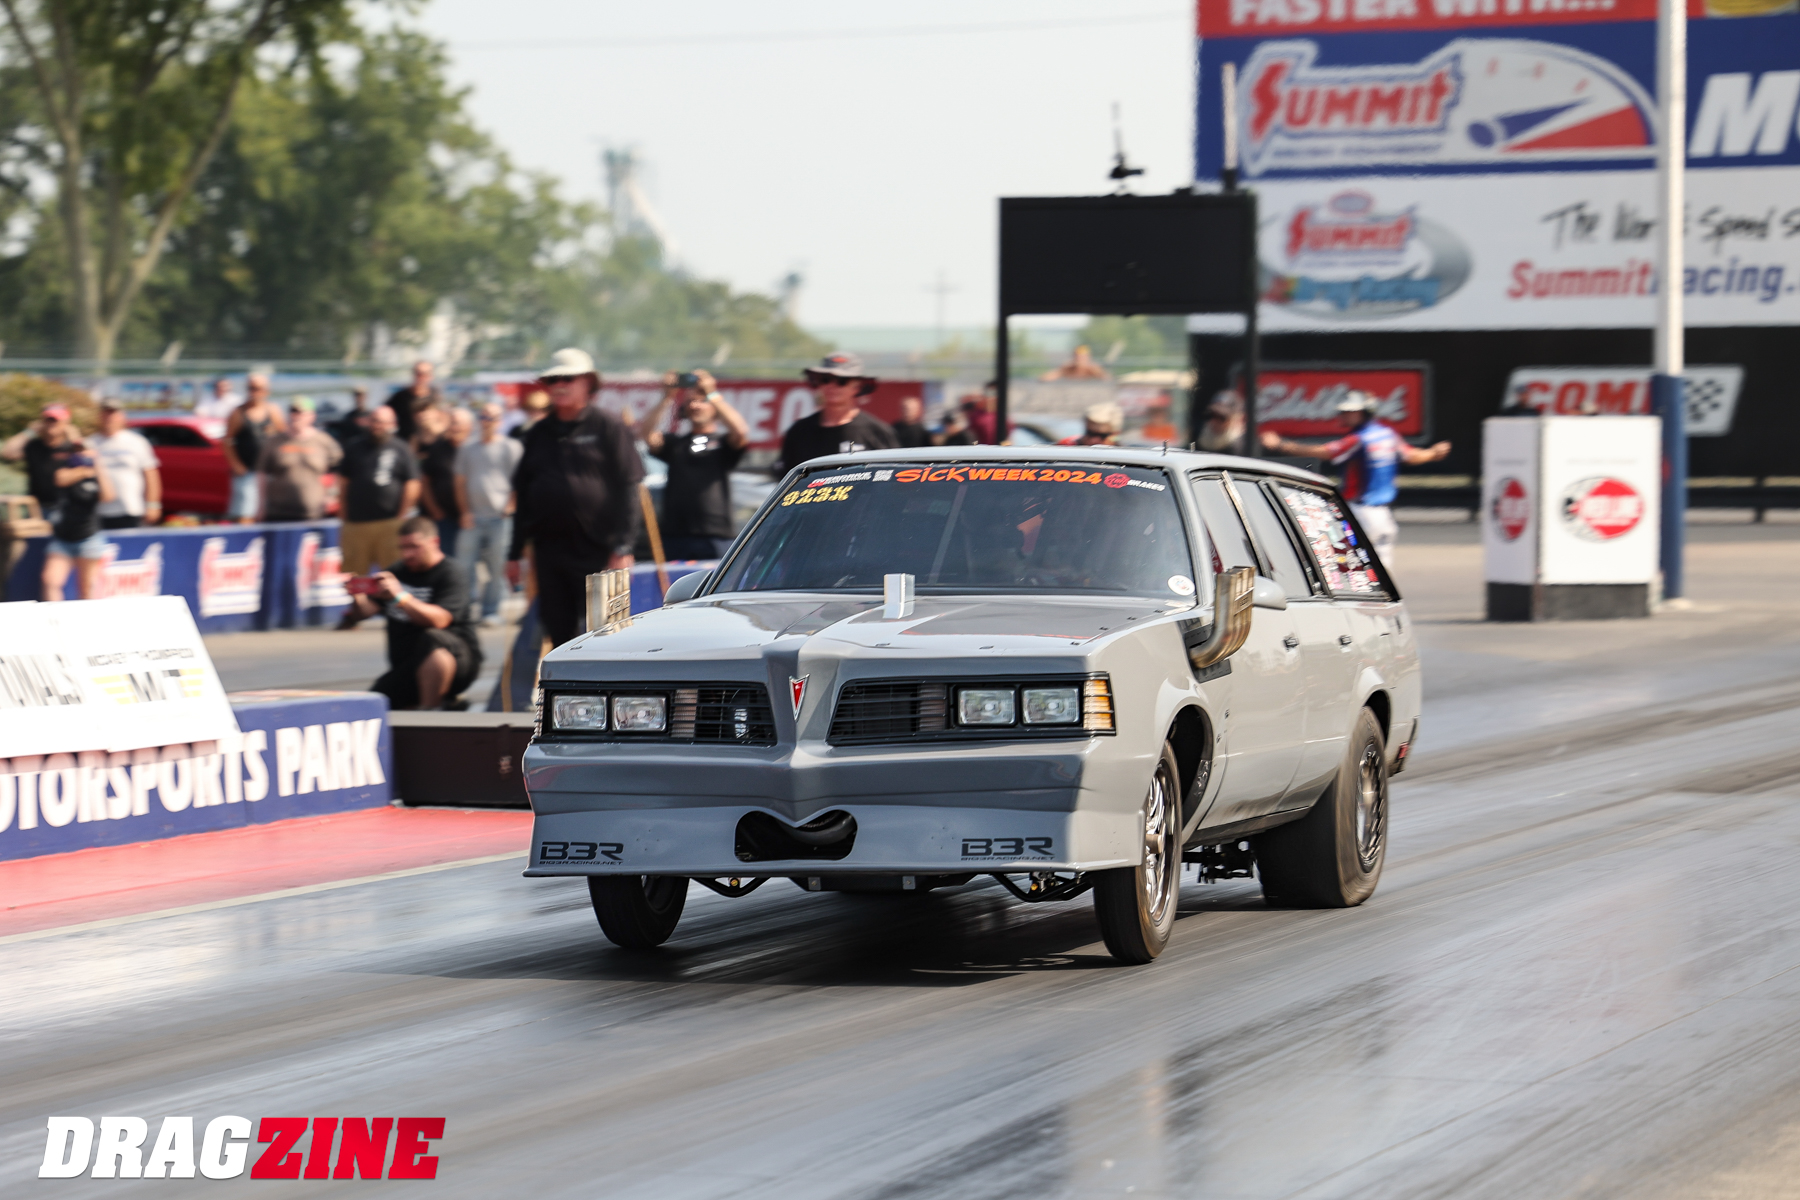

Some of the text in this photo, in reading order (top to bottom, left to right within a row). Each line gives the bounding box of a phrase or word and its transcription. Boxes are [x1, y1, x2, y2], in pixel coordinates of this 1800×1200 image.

[275, 718, 386, 797] PARK
[540, 841, 624, 861] B3R
[961, 836, 1055, 857] B3R
